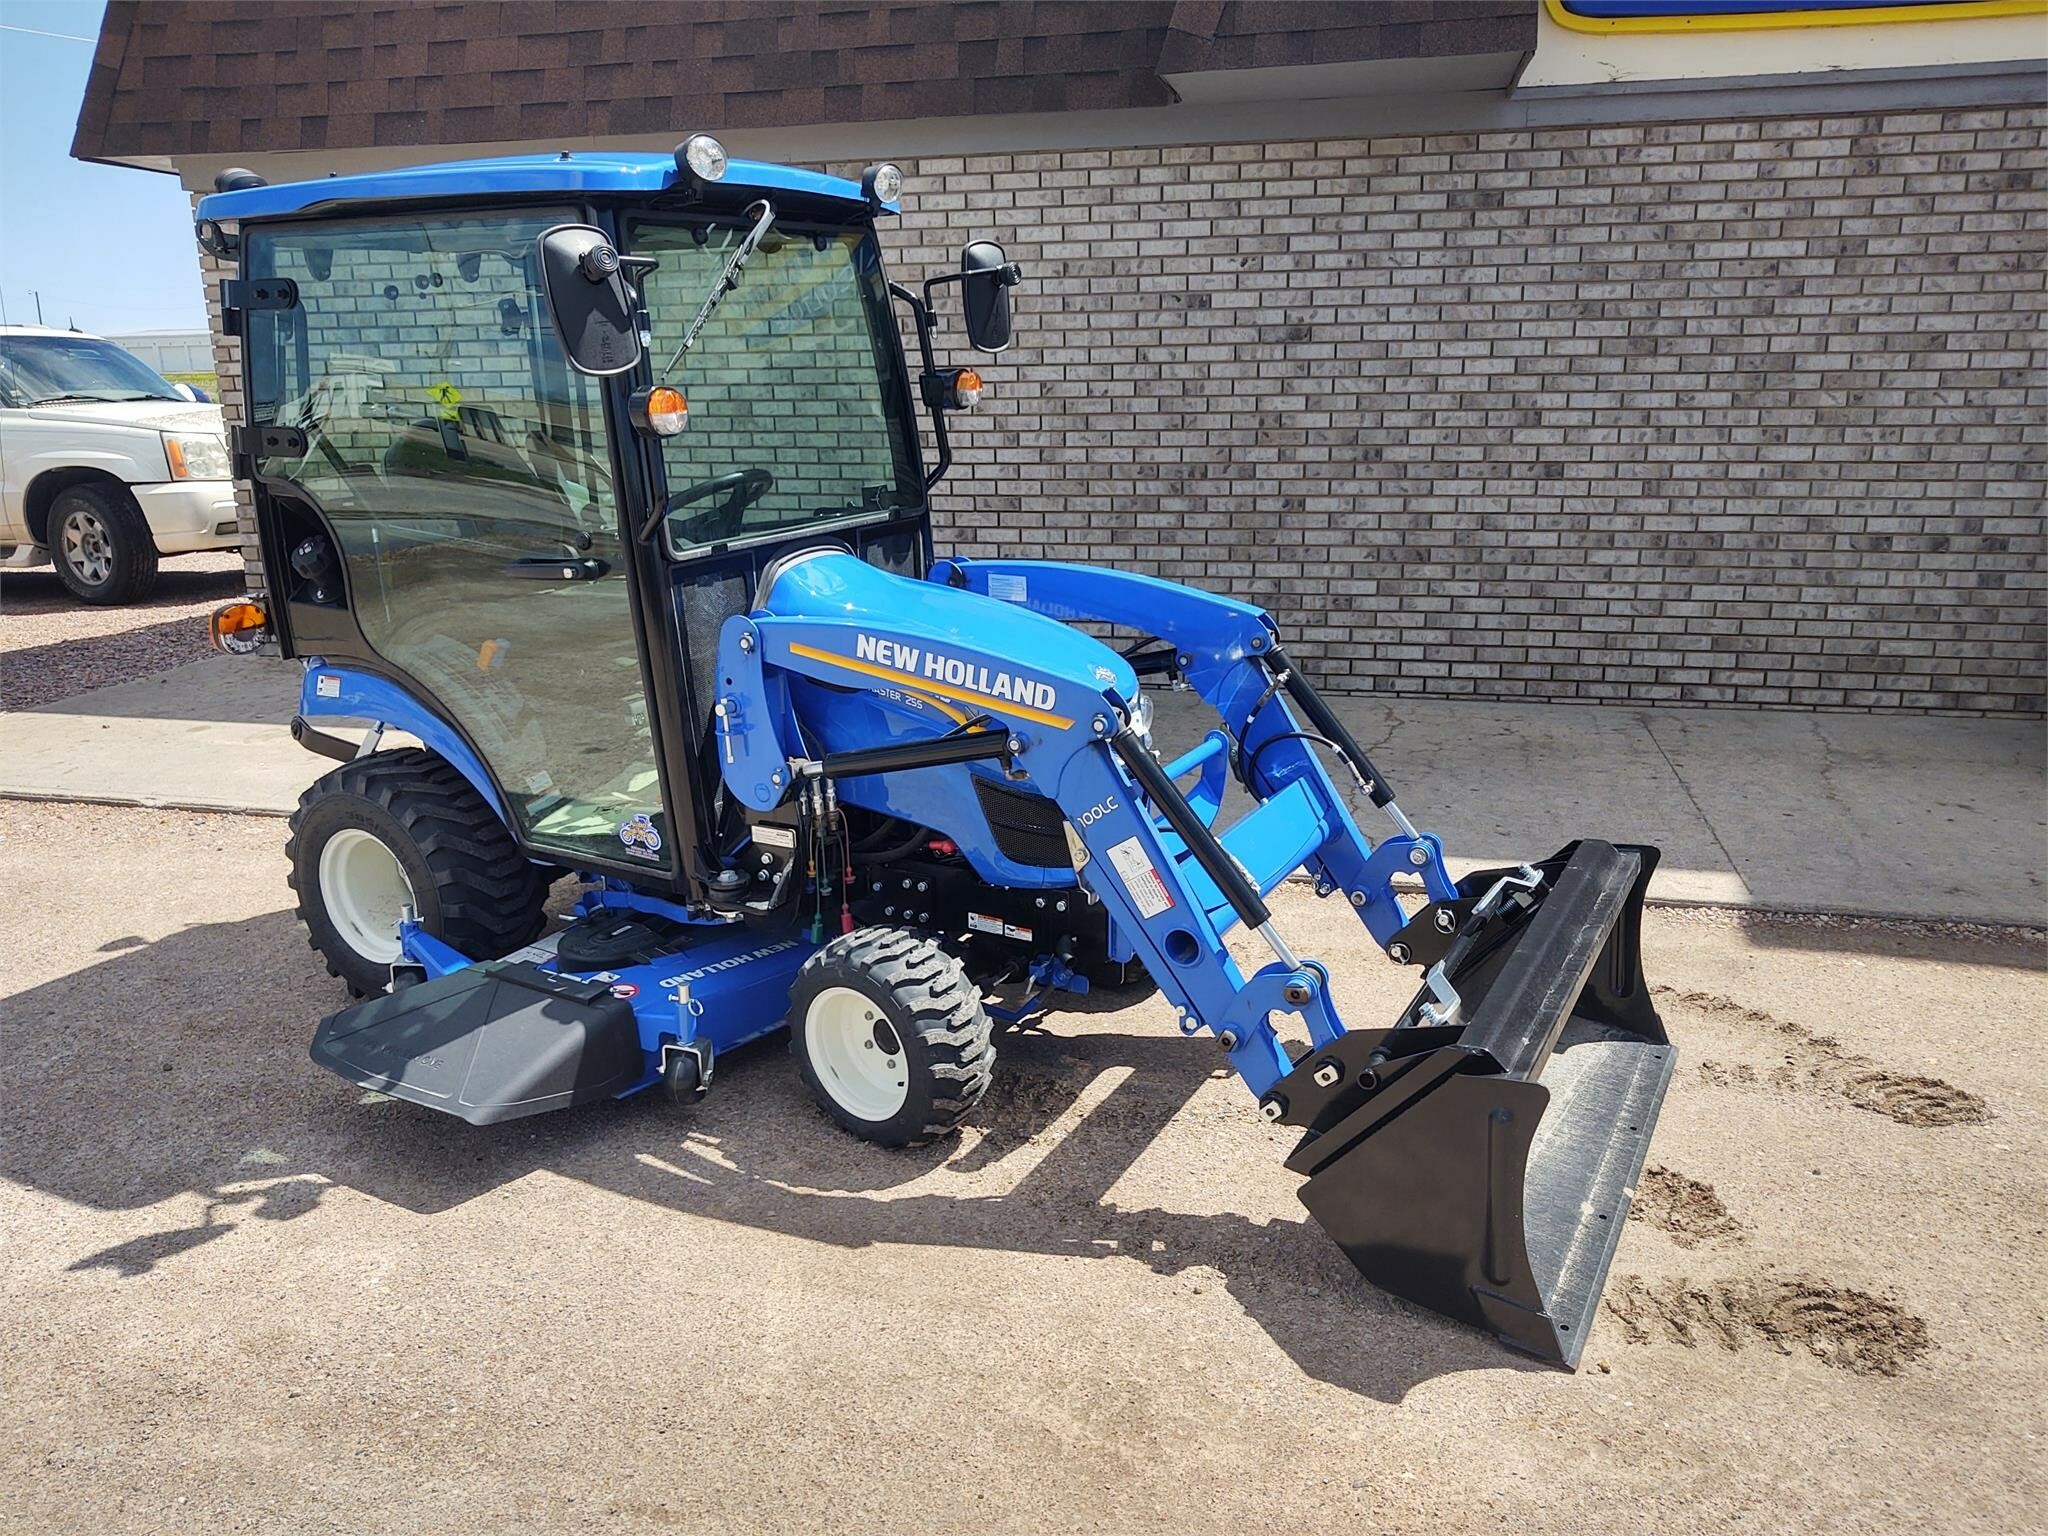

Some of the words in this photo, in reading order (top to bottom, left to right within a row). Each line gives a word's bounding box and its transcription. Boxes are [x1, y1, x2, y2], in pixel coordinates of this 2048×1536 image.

[856, 633, 920, 673] NEW
[924, 652, 1057, 712] HOLLAND
[867, 686, 902, 702] ASTER
[1077, 795, 1119, 828] 100LC
[752, 940, 800, 960] NEW
[659, 953, 754, 988] HOLLAND
